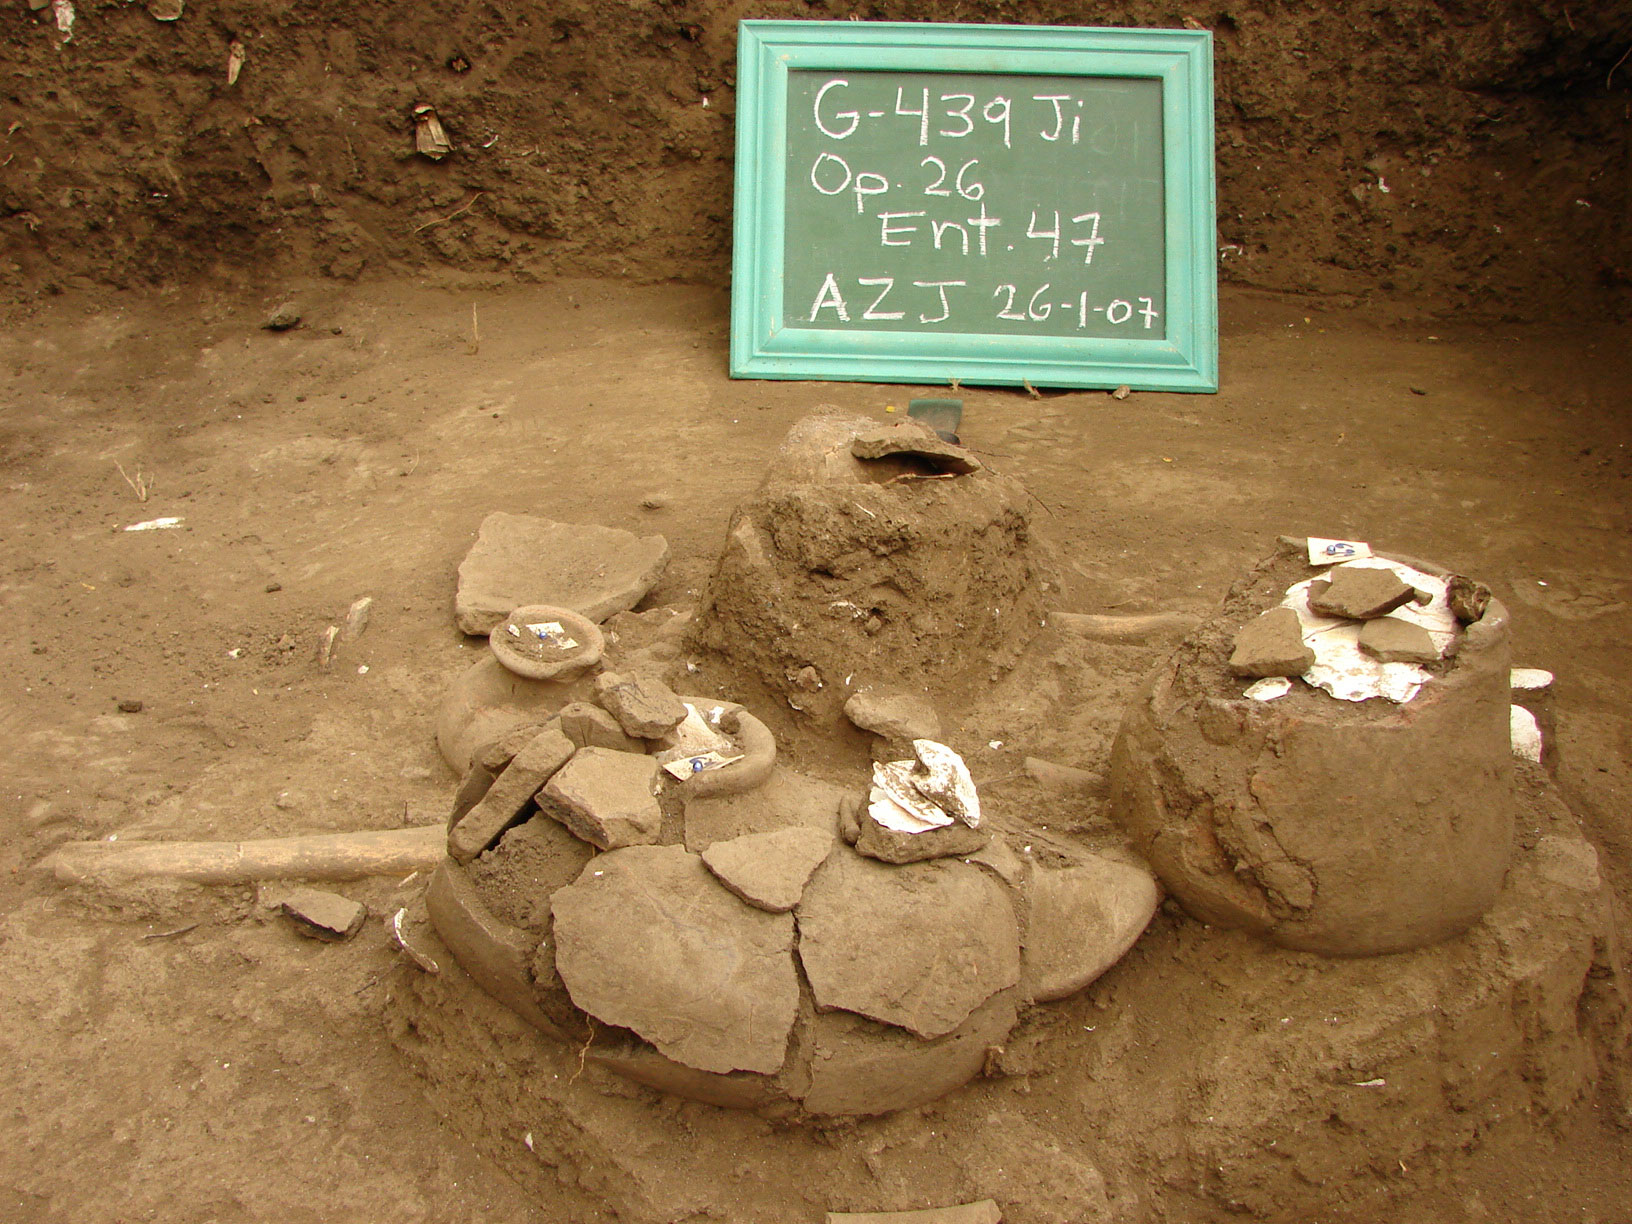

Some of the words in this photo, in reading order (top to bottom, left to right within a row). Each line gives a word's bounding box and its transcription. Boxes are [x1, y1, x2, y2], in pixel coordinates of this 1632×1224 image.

[813, 80, 1013, 148] G-439
[810, 152, 902, 214] Op.
[920, 156, 985, 200] 26
[877, 202, 1014, 256] Ent.
[1026, 210, 1105, 264] 47
[993, 283, 1159, 329] 26-1-07
